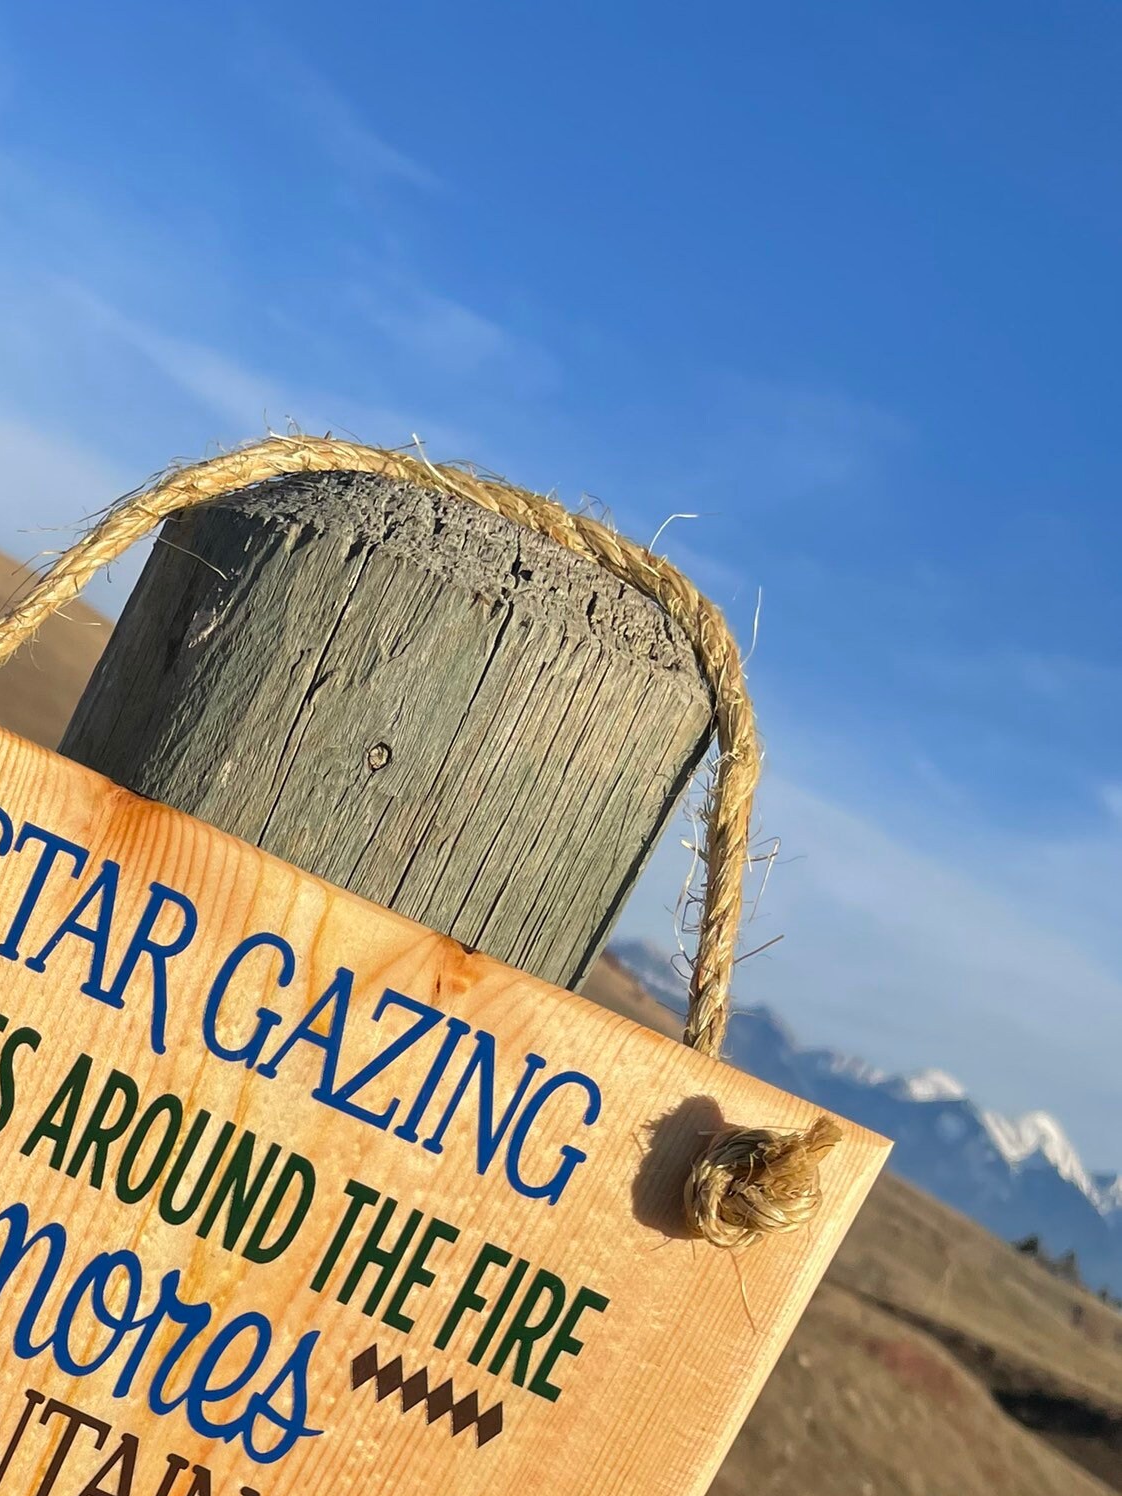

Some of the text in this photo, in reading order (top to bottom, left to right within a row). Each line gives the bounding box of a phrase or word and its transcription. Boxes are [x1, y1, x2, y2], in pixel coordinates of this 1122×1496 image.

[203, 932, 601, 1205] GAZING
[20, 1053, 315, 1264] AROUND
[310, 1179, 460, 1334] THE
[434, 1243, 610, 1402] FIRE
